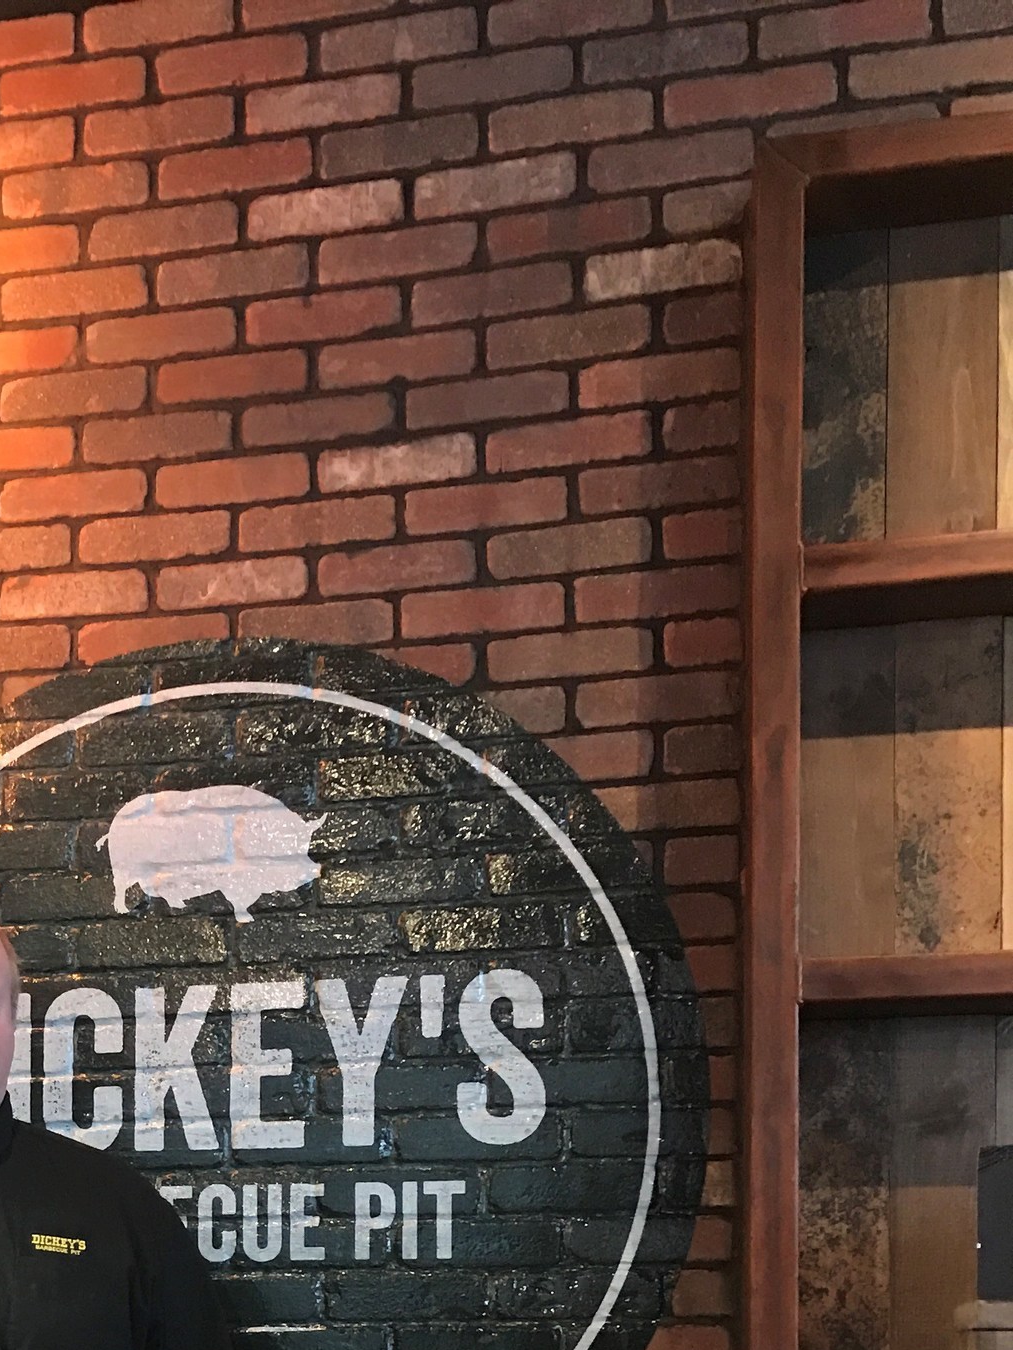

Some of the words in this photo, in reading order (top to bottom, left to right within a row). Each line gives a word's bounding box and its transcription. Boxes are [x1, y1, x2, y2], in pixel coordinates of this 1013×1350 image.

[7, 967, 547, 1153] ICKEY'S
[31, 1233, 87, 1251] DICKEY'S
[354, 1179, 467, 1262] PIT
